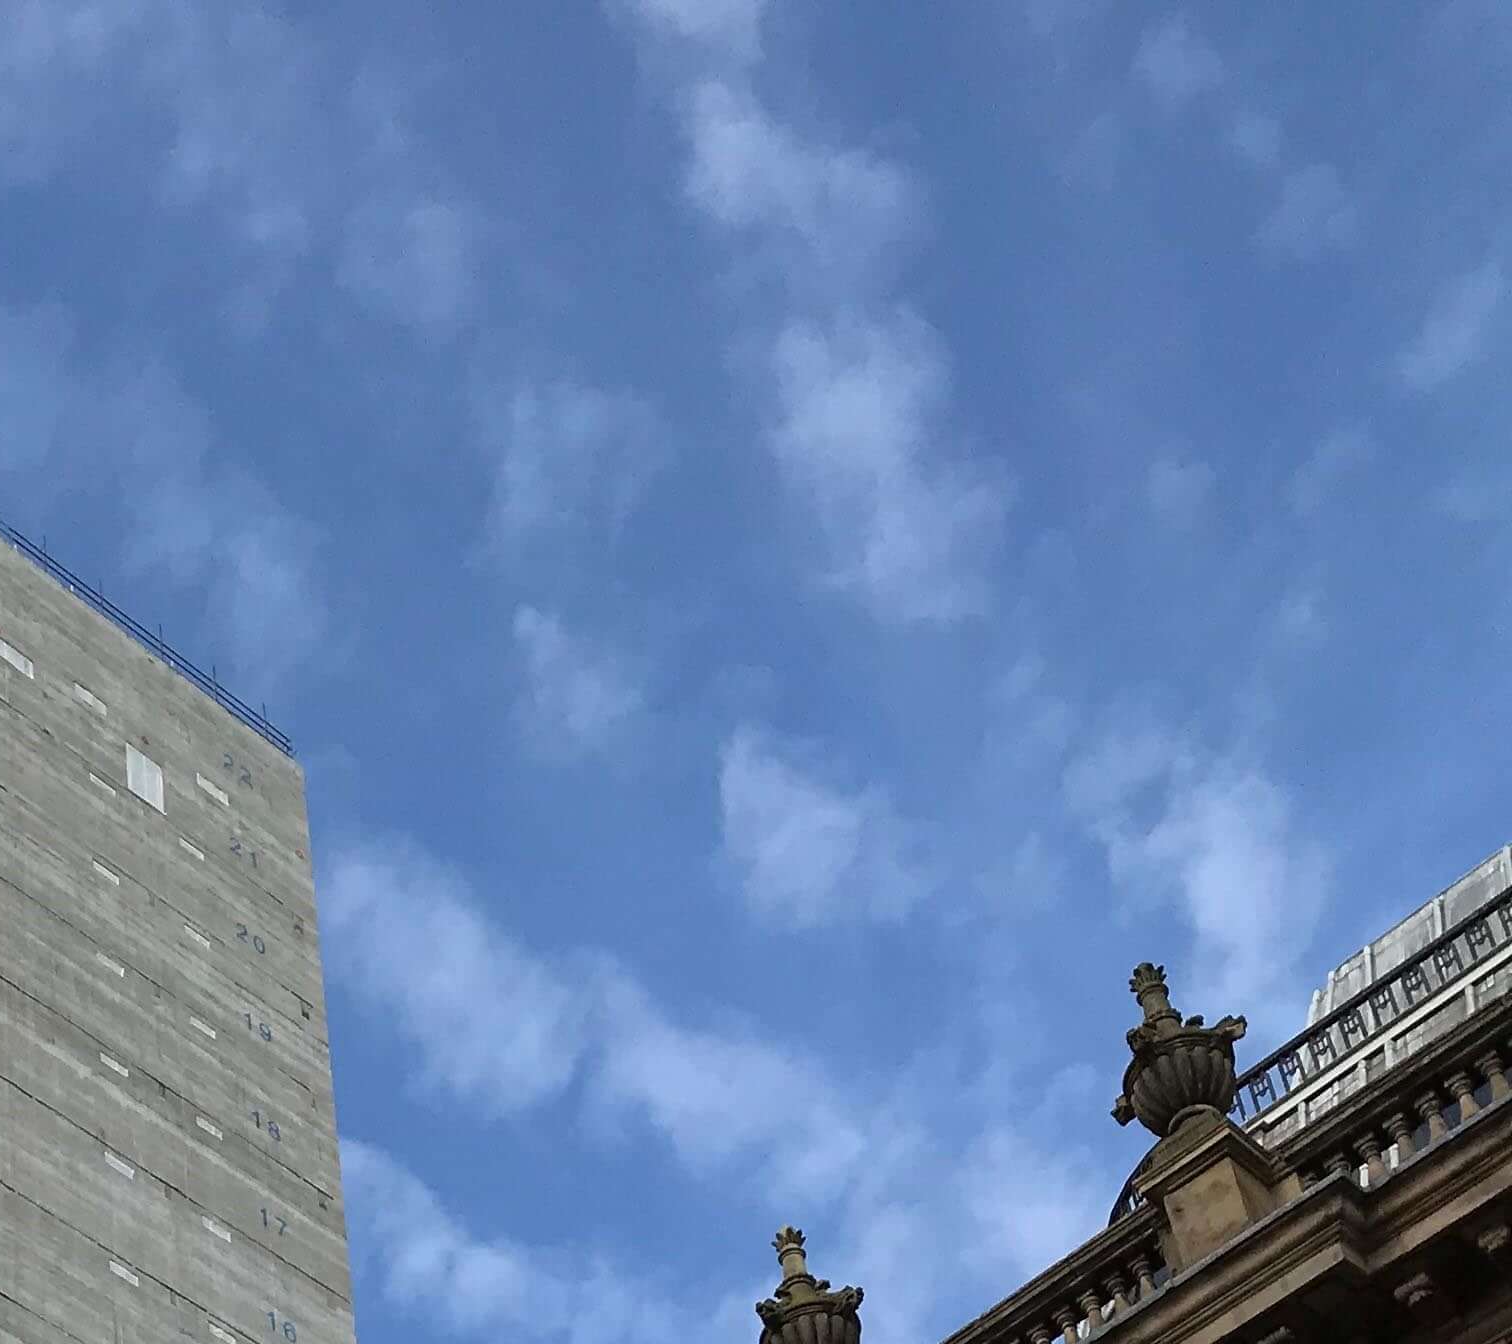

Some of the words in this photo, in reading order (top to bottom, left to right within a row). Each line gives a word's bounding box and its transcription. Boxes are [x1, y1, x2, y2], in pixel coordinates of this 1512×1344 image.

[229, 836, 259, 868] 21
[236, 923, 265, 955] 20
[243, 1012, 272, 1042] 19
[252, 1111, 282, 1142] 18
[259, 1208, 288, 1237] 17
[266, 1311, 298, 1344] 16
